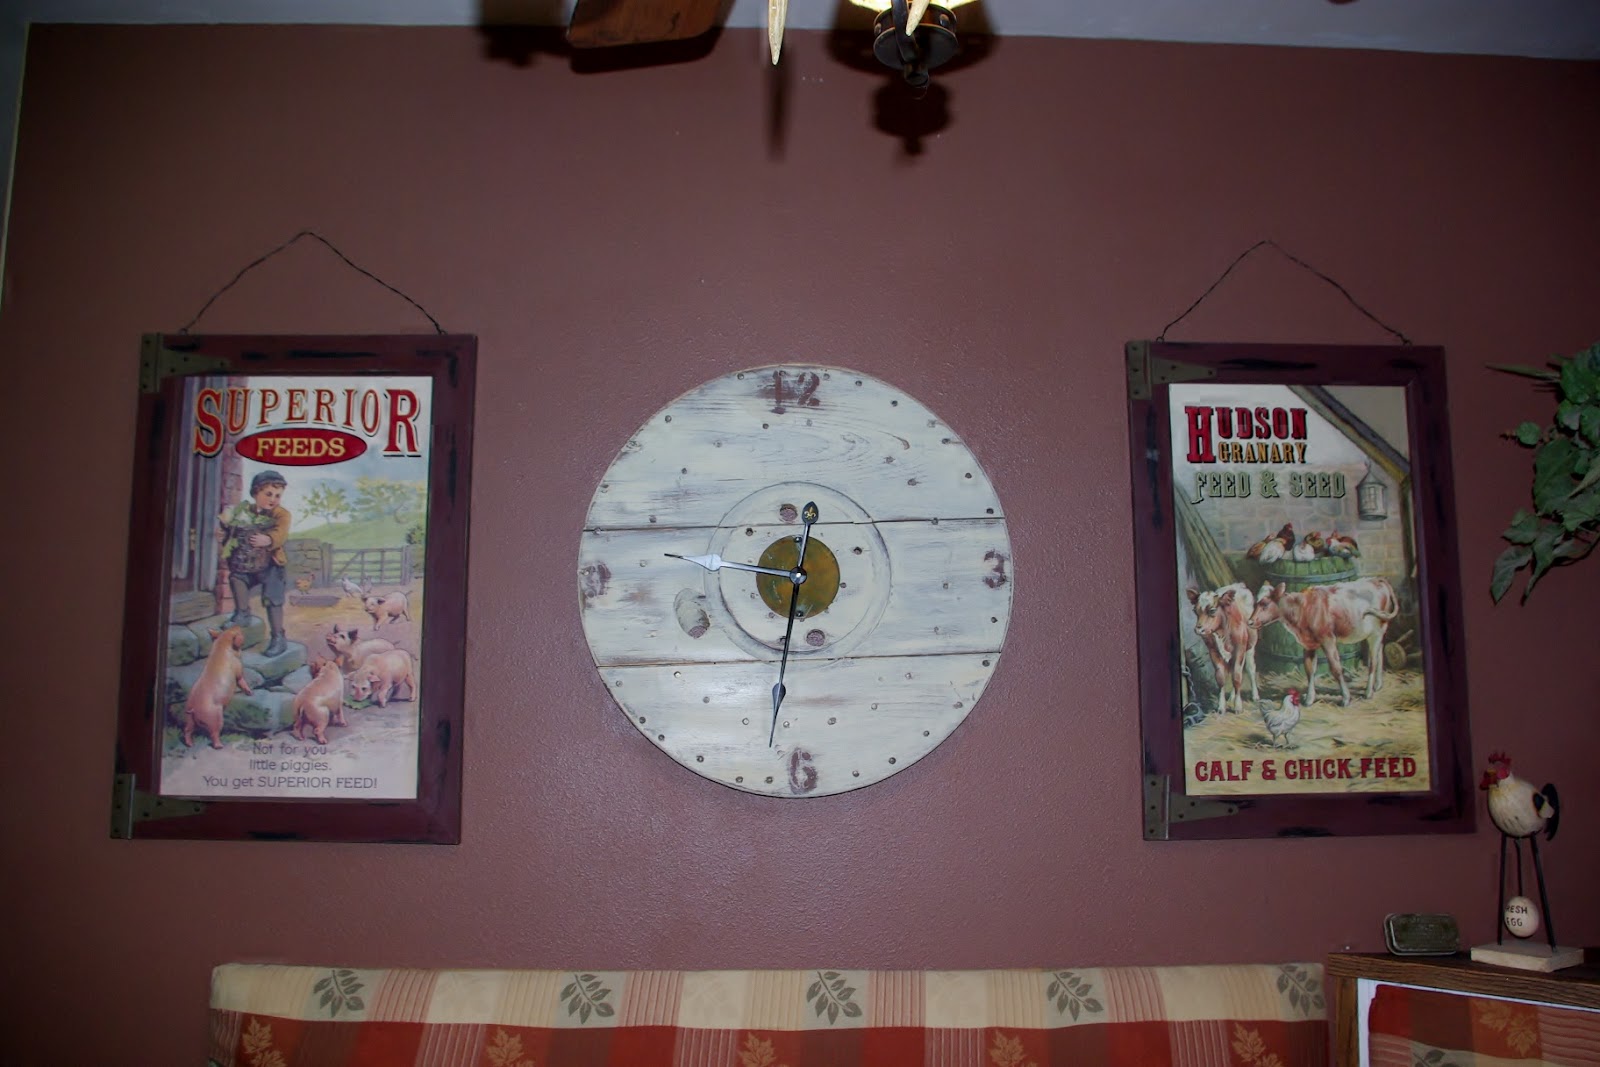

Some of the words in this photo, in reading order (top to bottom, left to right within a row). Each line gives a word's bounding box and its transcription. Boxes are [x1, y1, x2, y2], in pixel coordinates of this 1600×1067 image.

[772, 370, 821, 415] 12
[193, 388, 421, 457] SUPERIOR
[1185, 405, 1307, 463] HUDSON
[256, 437, 346, 457] FEEDS
[1217, 442, 1307, 463] GRANARY
[1191, 471, 1251, 504] FEED
[1259, 469, 1279, 498] &
[1289, 471, 1346, 498] SEED
[983, 549, 1007, 589] 3
[253, 742, 273, 754] Not
[280, 742, 298, 755] for
[304, 744, 327, 758] you
[249, 760, 277, 771] little
[280, 760, 332, 773] piggies.
[788, 748, 818, 795] 6
[1195, 760, 1254, 782] CALF
[1261, 759, 1278, 781] &
[1284, 758, 1353, 780] CHICK
[1360, 757, 1417, 779] FEED
[203, 776, 228, 787] You
[232, 776, 254, 790] get
[257, 776, 332, 788] SUPERIOR
[335, 777, 378, 789] FEED!
[1505, 905, 1528, 914] RESH
[1506, 917, 1523, 927] EGG
